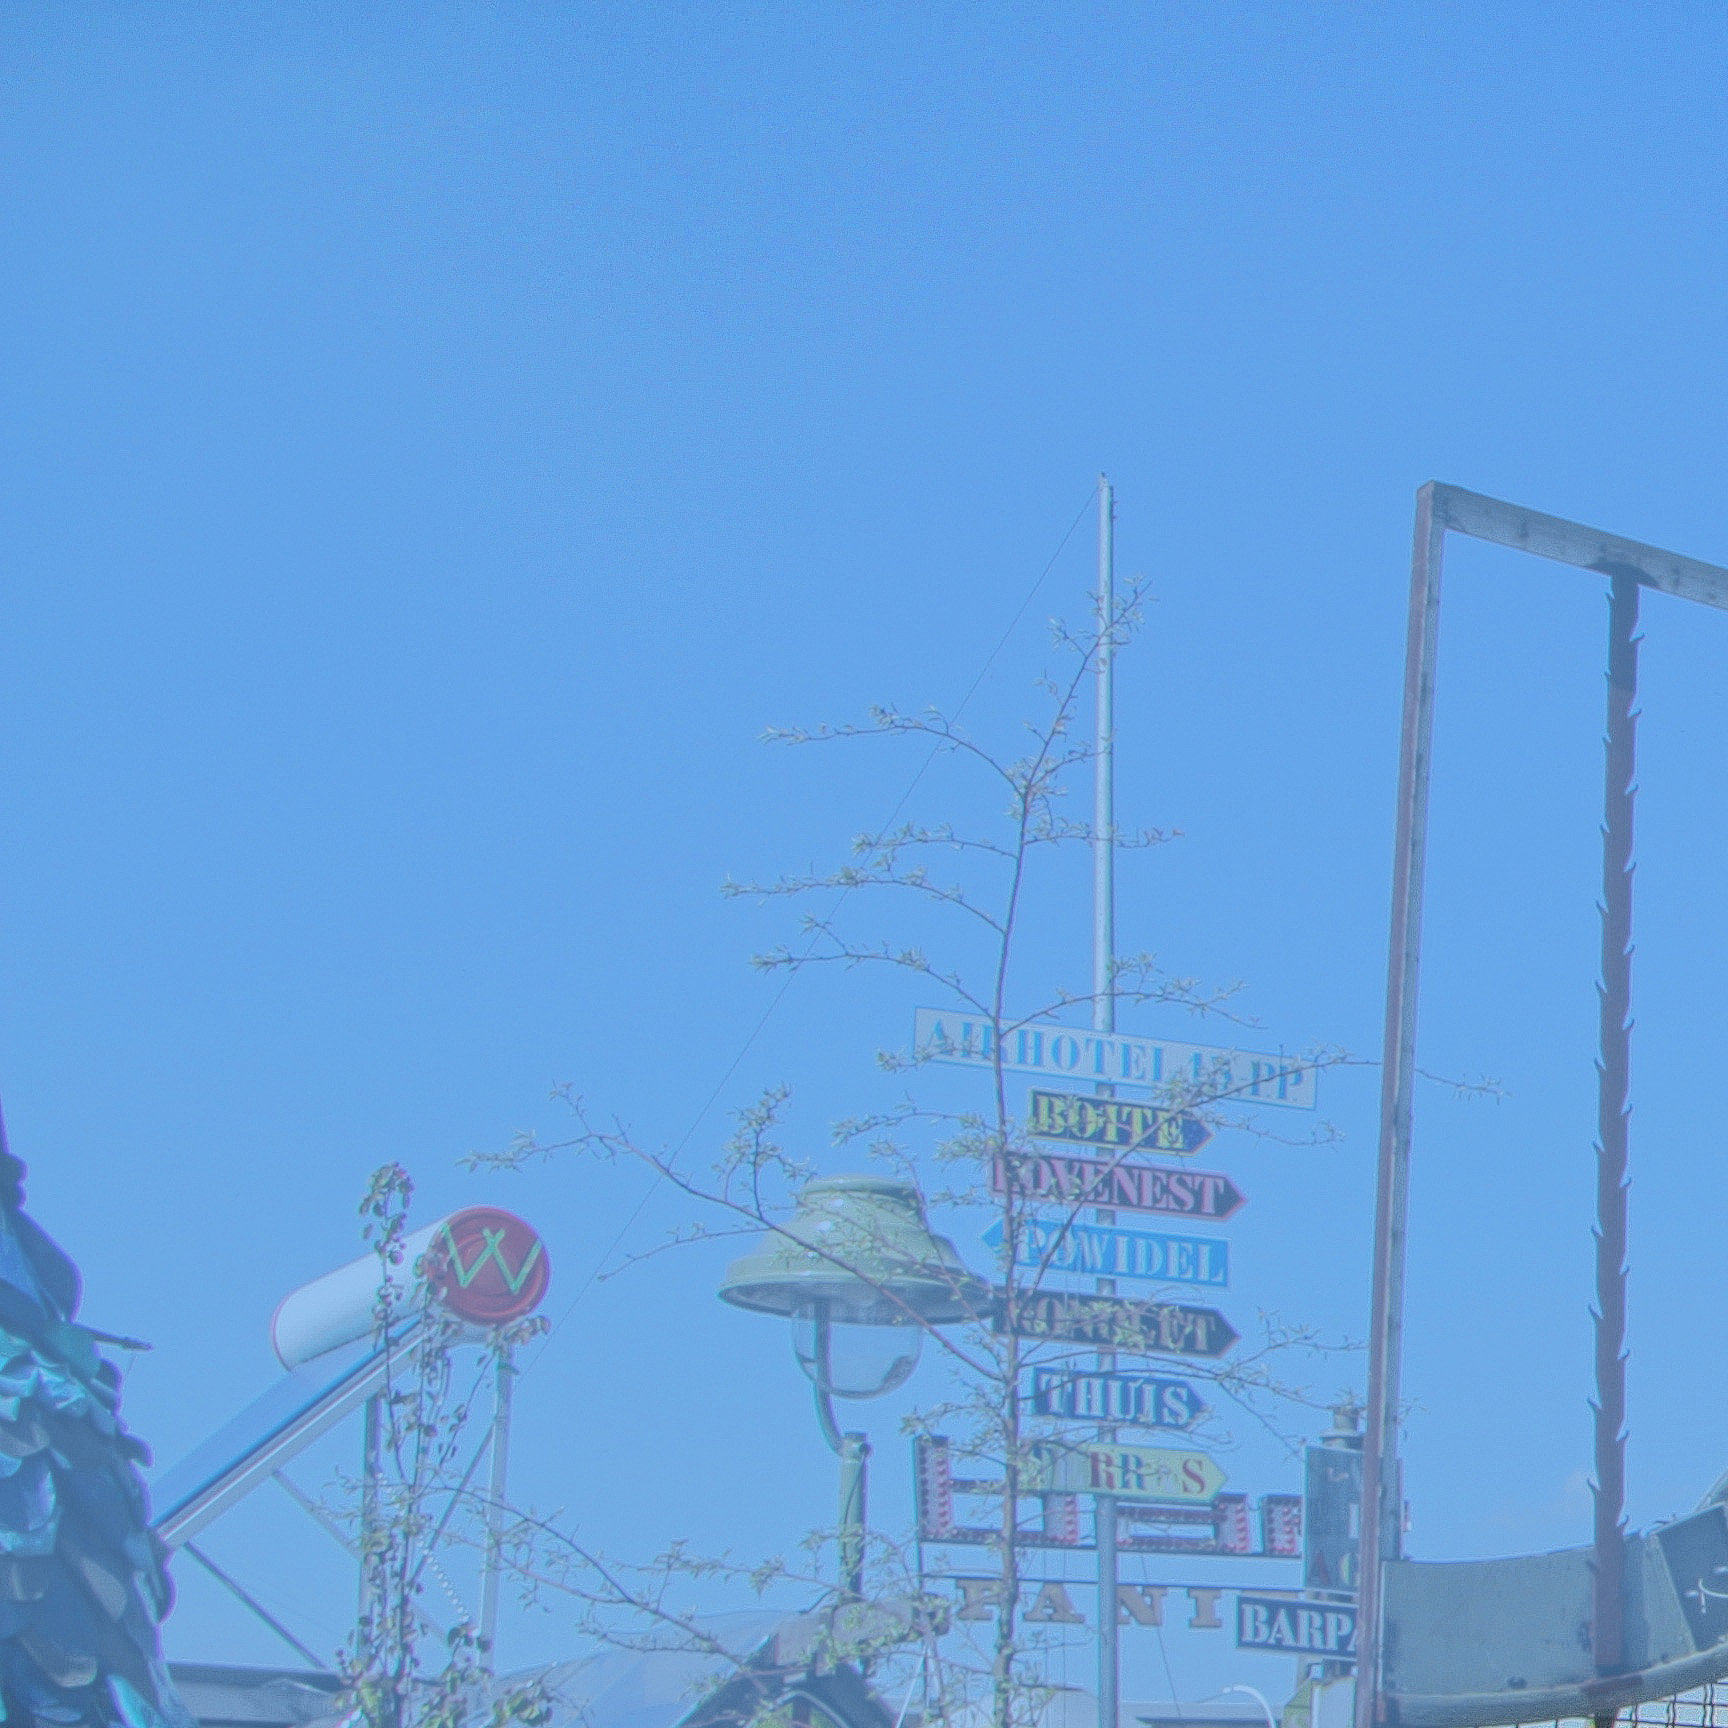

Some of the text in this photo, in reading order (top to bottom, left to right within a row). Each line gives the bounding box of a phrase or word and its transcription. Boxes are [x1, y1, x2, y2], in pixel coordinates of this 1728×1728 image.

[441, 1222, 542, 1295] W
[1040, 1373, 1190, 1426] THUIS
[1241, 1602, 1358, 1653] BARP
